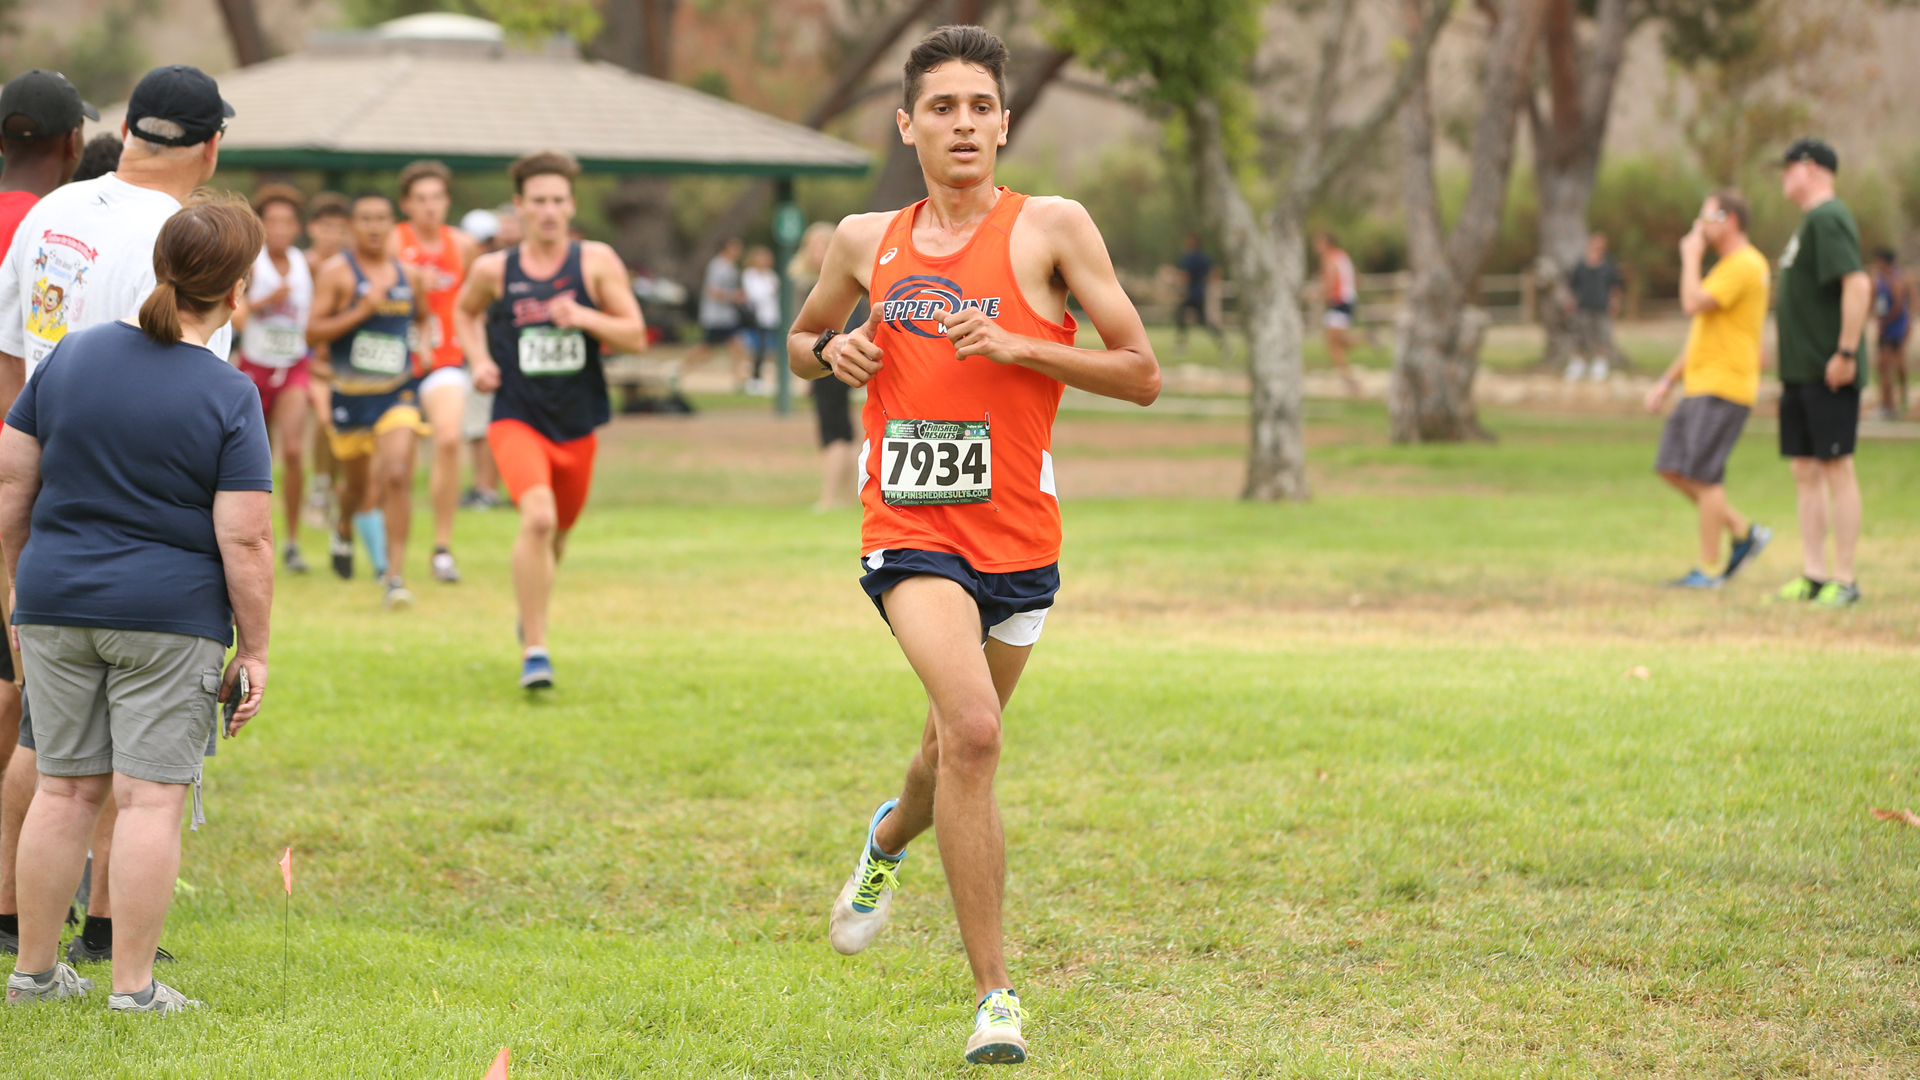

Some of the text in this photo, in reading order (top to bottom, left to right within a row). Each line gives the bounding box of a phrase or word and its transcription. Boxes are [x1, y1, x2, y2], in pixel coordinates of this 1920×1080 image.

[525, 342, 579, 362] 7684
[926, 423, 960, 432] FINISHED
[887, 441, 987, 487] 7934
[884, 489, 989, 499] WWW.FINISHEDRESULTS.COM
